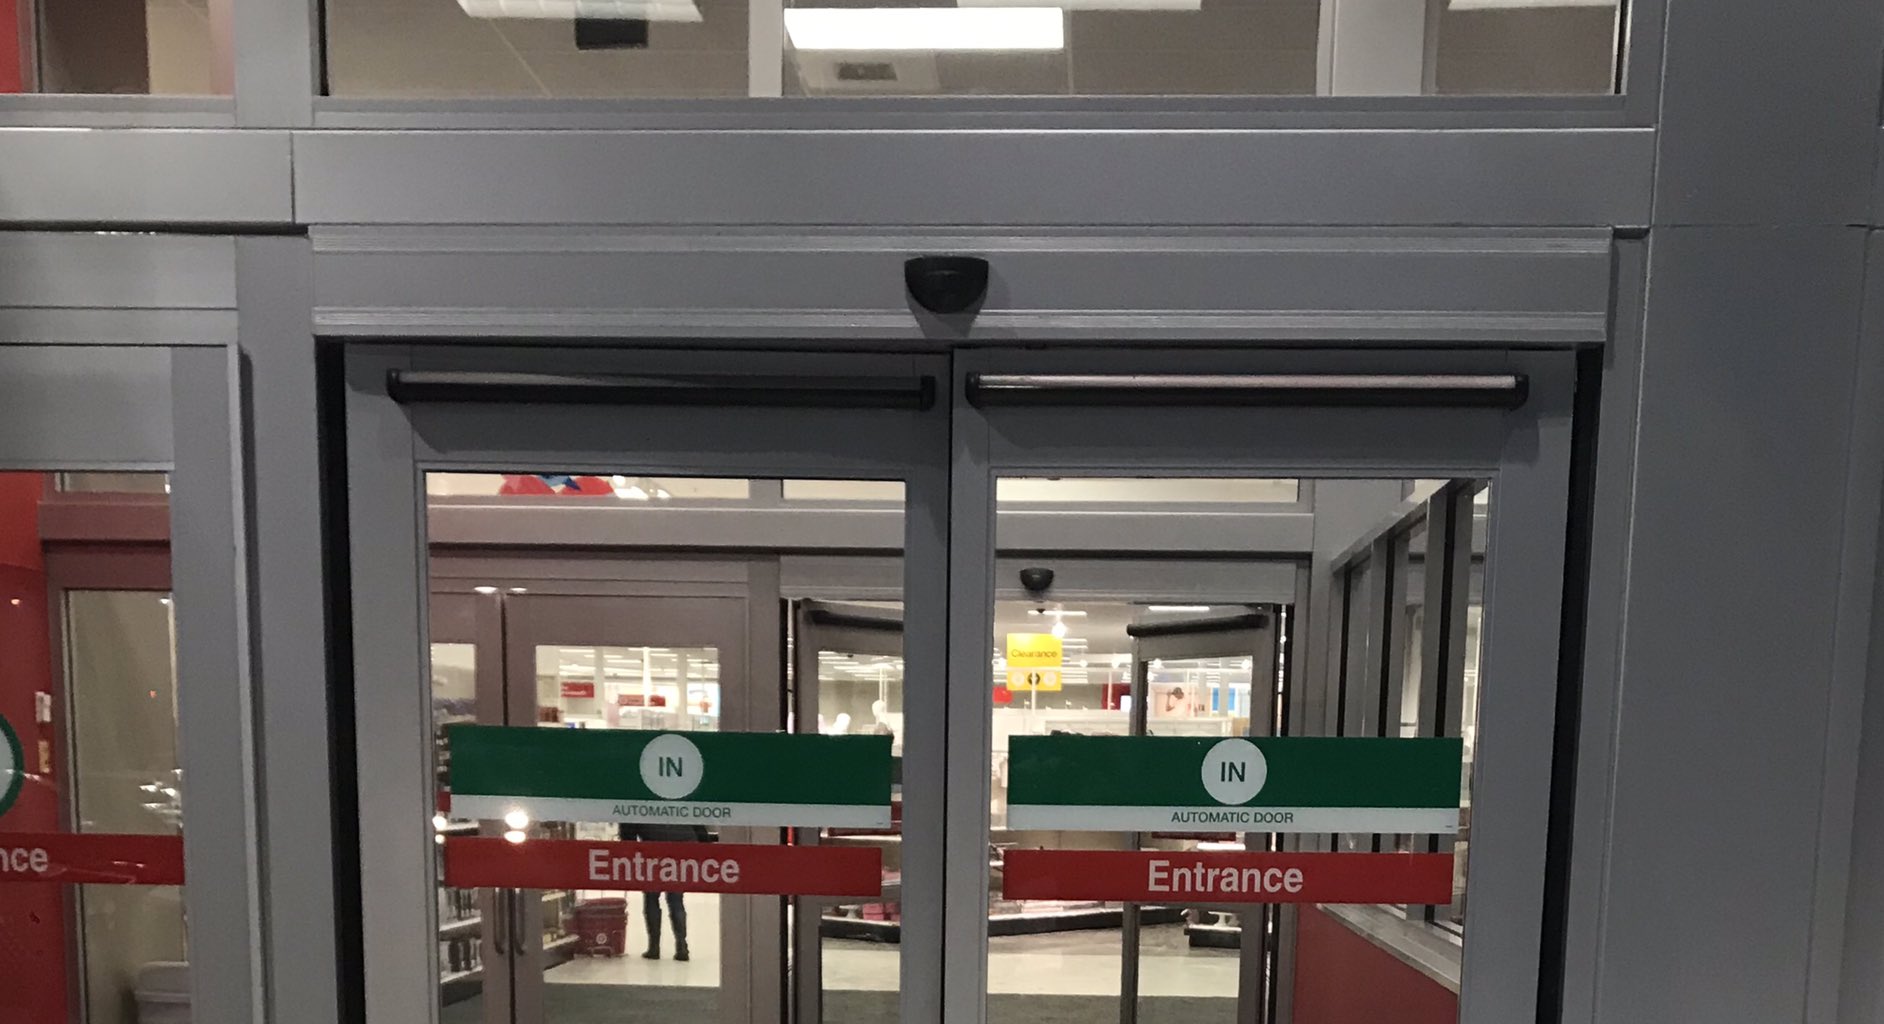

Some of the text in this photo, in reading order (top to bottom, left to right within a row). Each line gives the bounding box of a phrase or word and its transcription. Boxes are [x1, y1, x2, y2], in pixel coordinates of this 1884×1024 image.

[1011, 648, 1058, 658] Clearance
[658, 757, 683, 778] IN
[1220, 761, 1246, 783] IN
[612, 805, 732, 819] AUTOMATIC DOOR
[1171, 811, 1294, 824] AUTOMATIC DOOR
[588, 848, 740, 884] Entrance
[1147, 859, 1304, 893] Entrance
